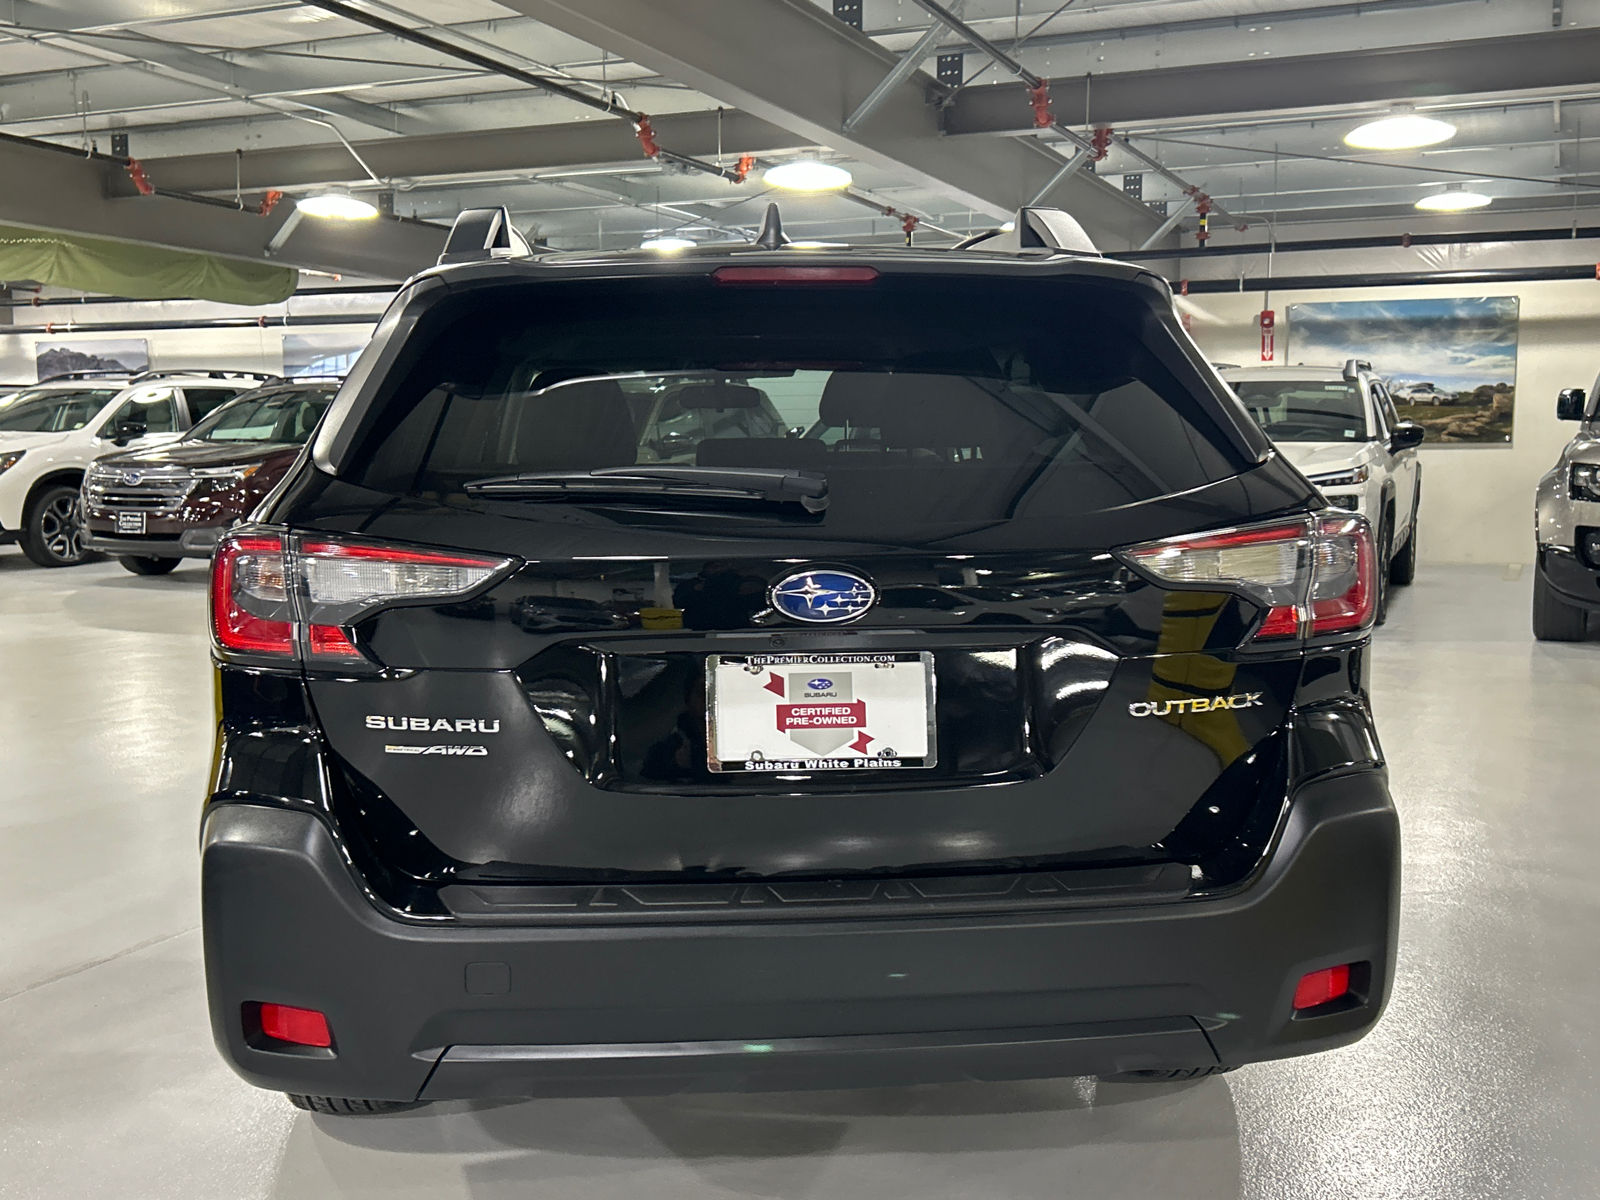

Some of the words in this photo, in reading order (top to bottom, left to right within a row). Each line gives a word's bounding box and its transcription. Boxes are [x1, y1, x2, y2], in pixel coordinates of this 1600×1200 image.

[1128, 691, 1264, 717] OUTBACK
[791, 707, 851, 716] CERTIFIED
[365, 715, 500, 733] SUBARU
[786, 716, 857, 725] PRE-OWNED
[422, 745, 488, 756] AWD
[745, 761, 799, 770] Subaru
[805, 759, 849, 769] White
[854, 758, 901, 768] Plains
